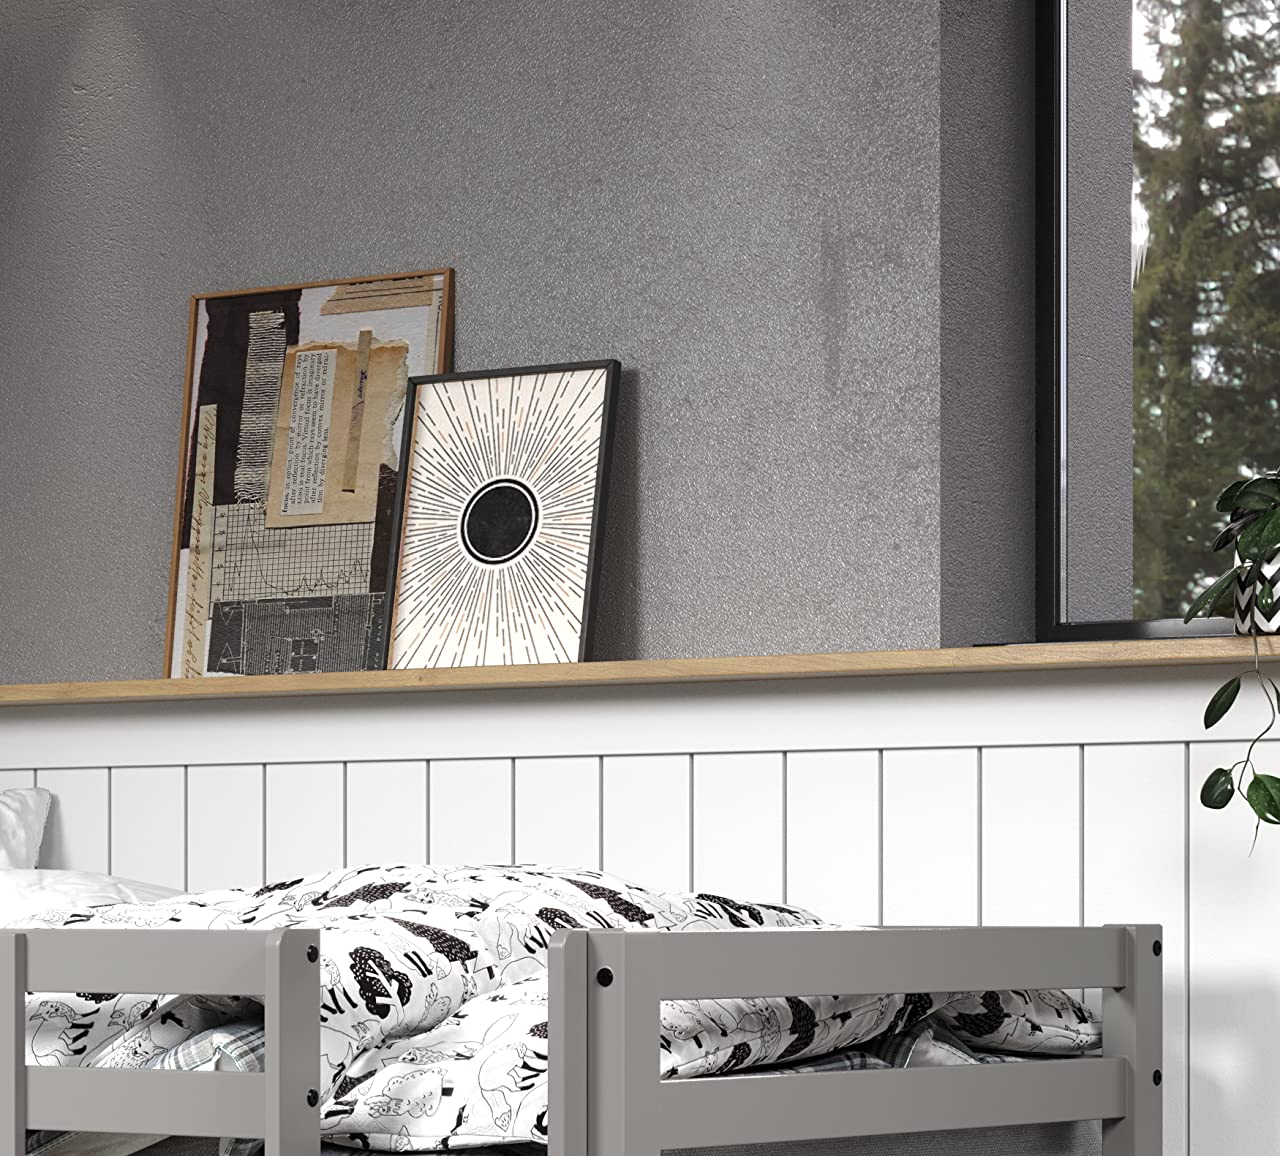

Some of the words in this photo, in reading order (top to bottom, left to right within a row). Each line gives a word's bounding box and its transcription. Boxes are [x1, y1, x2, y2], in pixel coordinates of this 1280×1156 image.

[307, 354, 316, 387] imaginary
[312, 453, 320, 484] reflection
[319, 444, 328, 476] diverging
[282, 492, 290, 512] focus,
